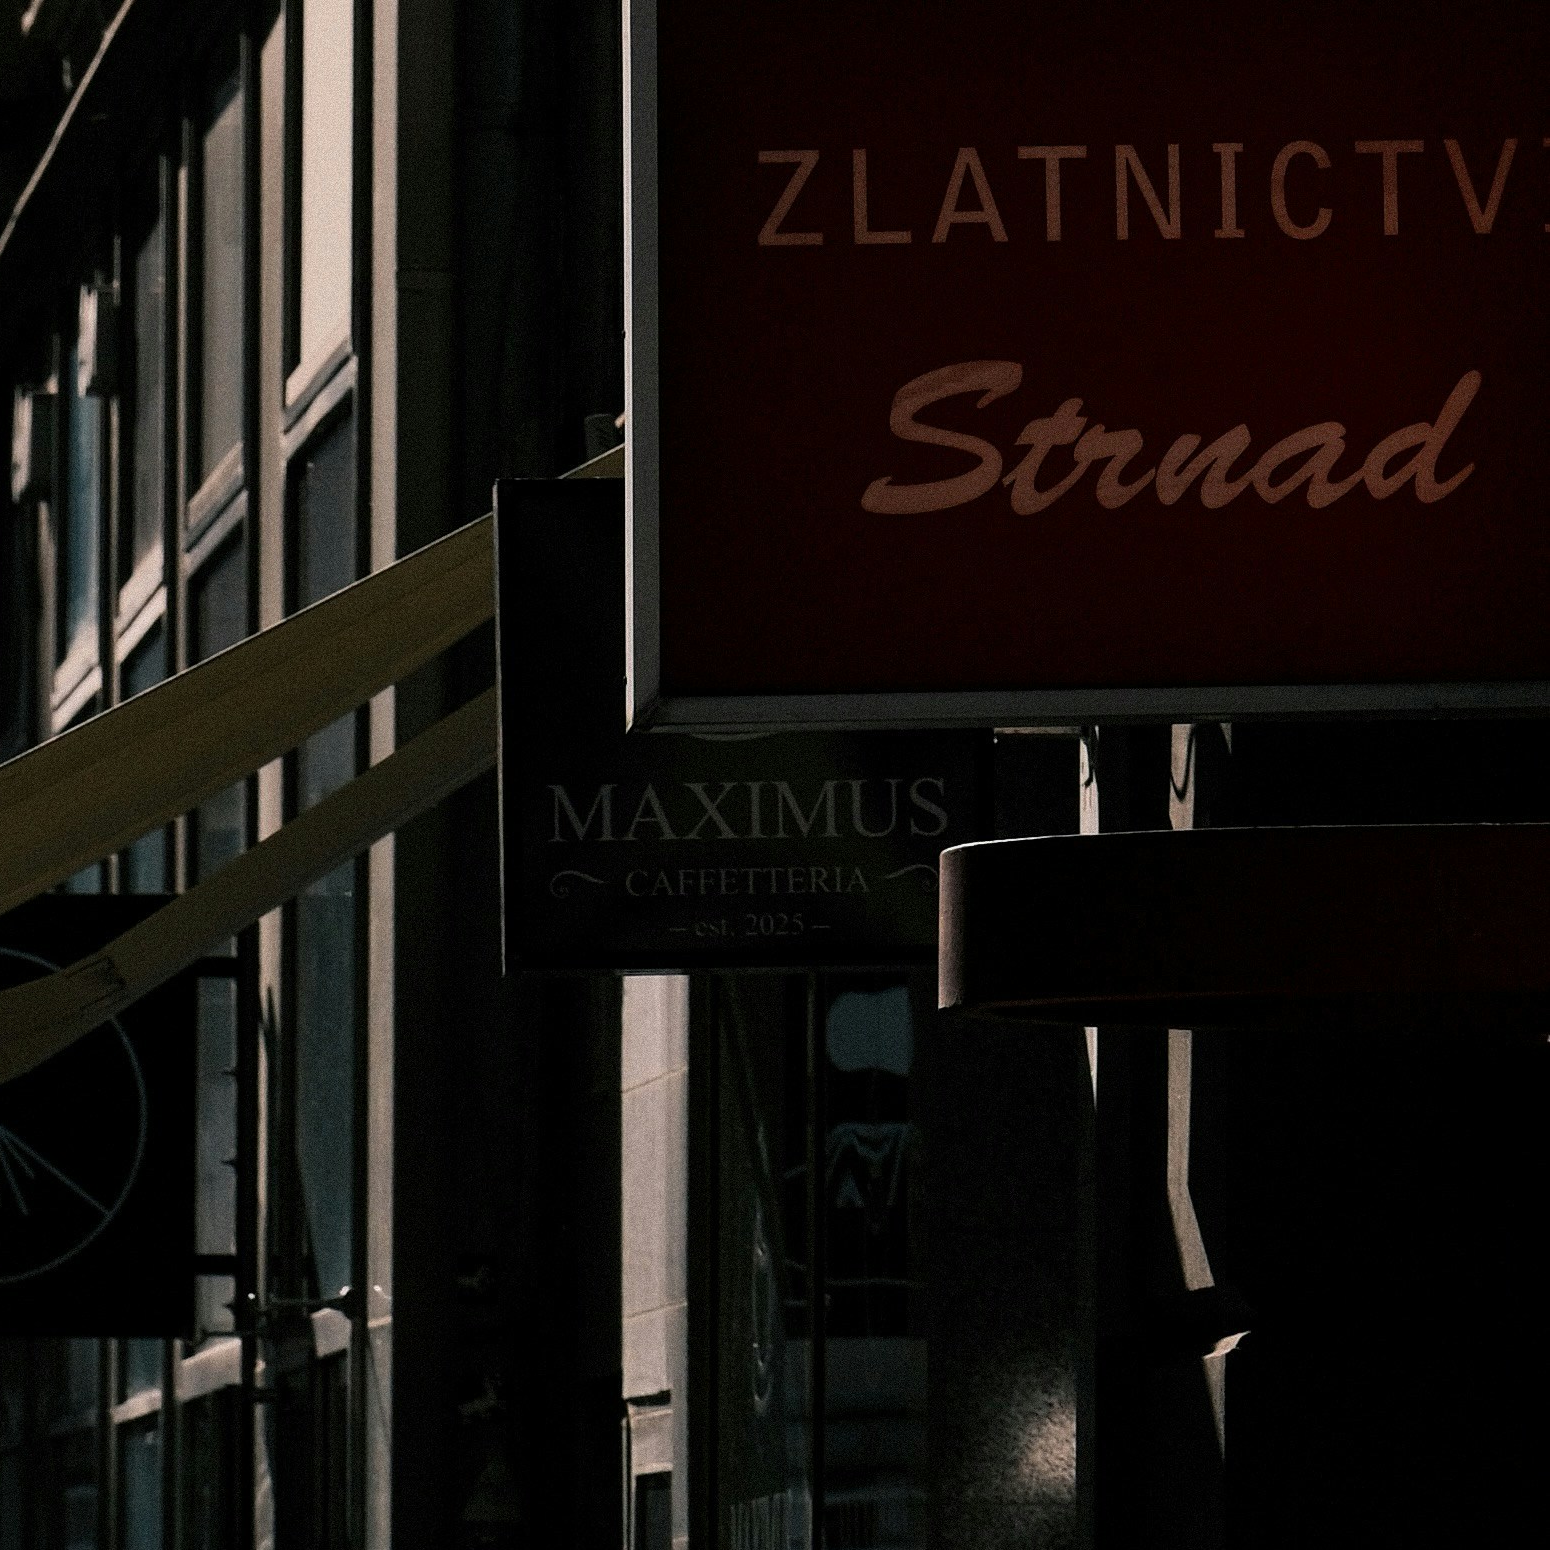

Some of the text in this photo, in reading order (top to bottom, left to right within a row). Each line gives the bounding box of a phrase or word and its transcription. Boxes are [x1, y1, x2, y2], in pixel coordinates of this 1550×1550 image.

[756, 137, 1550, 247] ZLATNICTV
[861, 359, 1482, 516] Strnad
[547, 776, 949, 843] MAXIMUS
[625, 866, 871, 897] CAFFETTERIA
[694, 912, 806, 937] est. 2025
